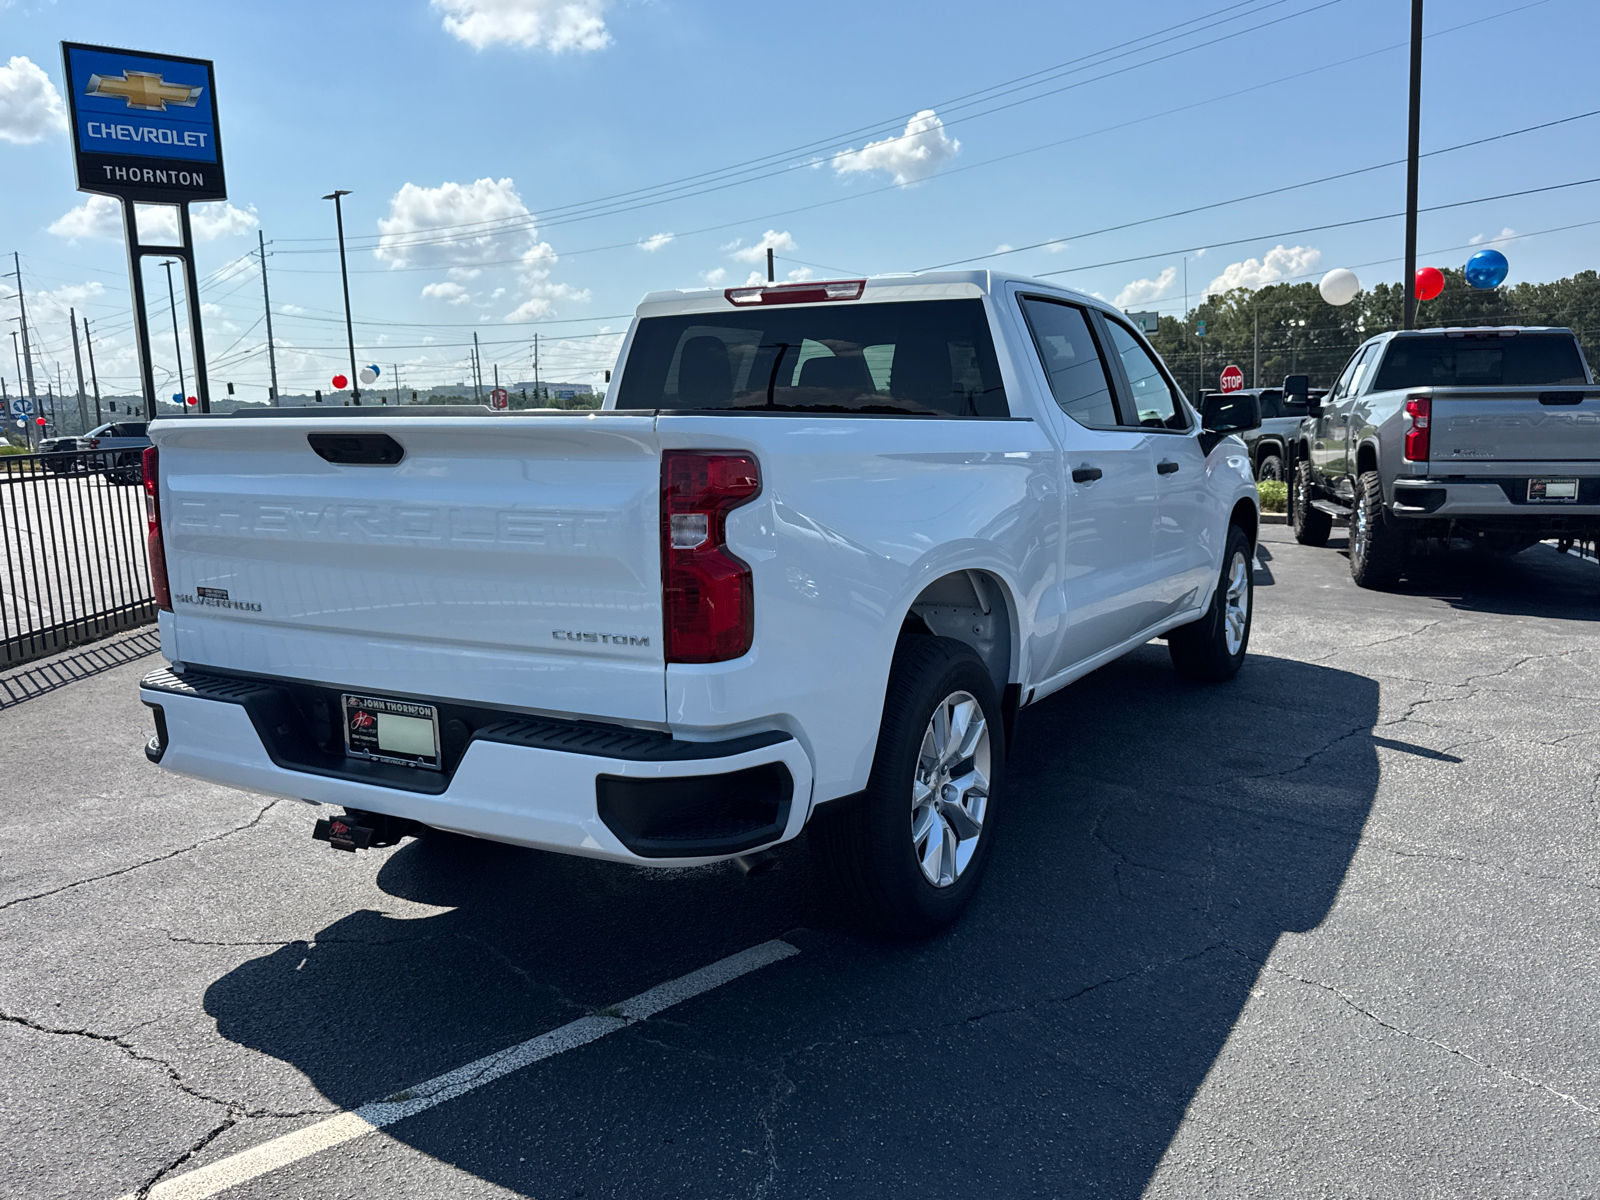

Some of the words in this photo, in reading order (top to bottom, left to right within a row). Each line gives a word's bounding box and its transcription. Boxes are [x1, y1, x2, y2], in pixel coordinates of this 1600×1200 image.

[87, 121, 208, 148] CHEVROLET
[102, 165, 204, 187] THORNTON
[1222, 375, 1242, 390] STOP
[177, 498, 607, 546] CHEVROLET
[552, 629, 650, 647] CUSTOM
[362, 699, 385, 710] JOHN
[386, 702, 431, 716] THORNTON
